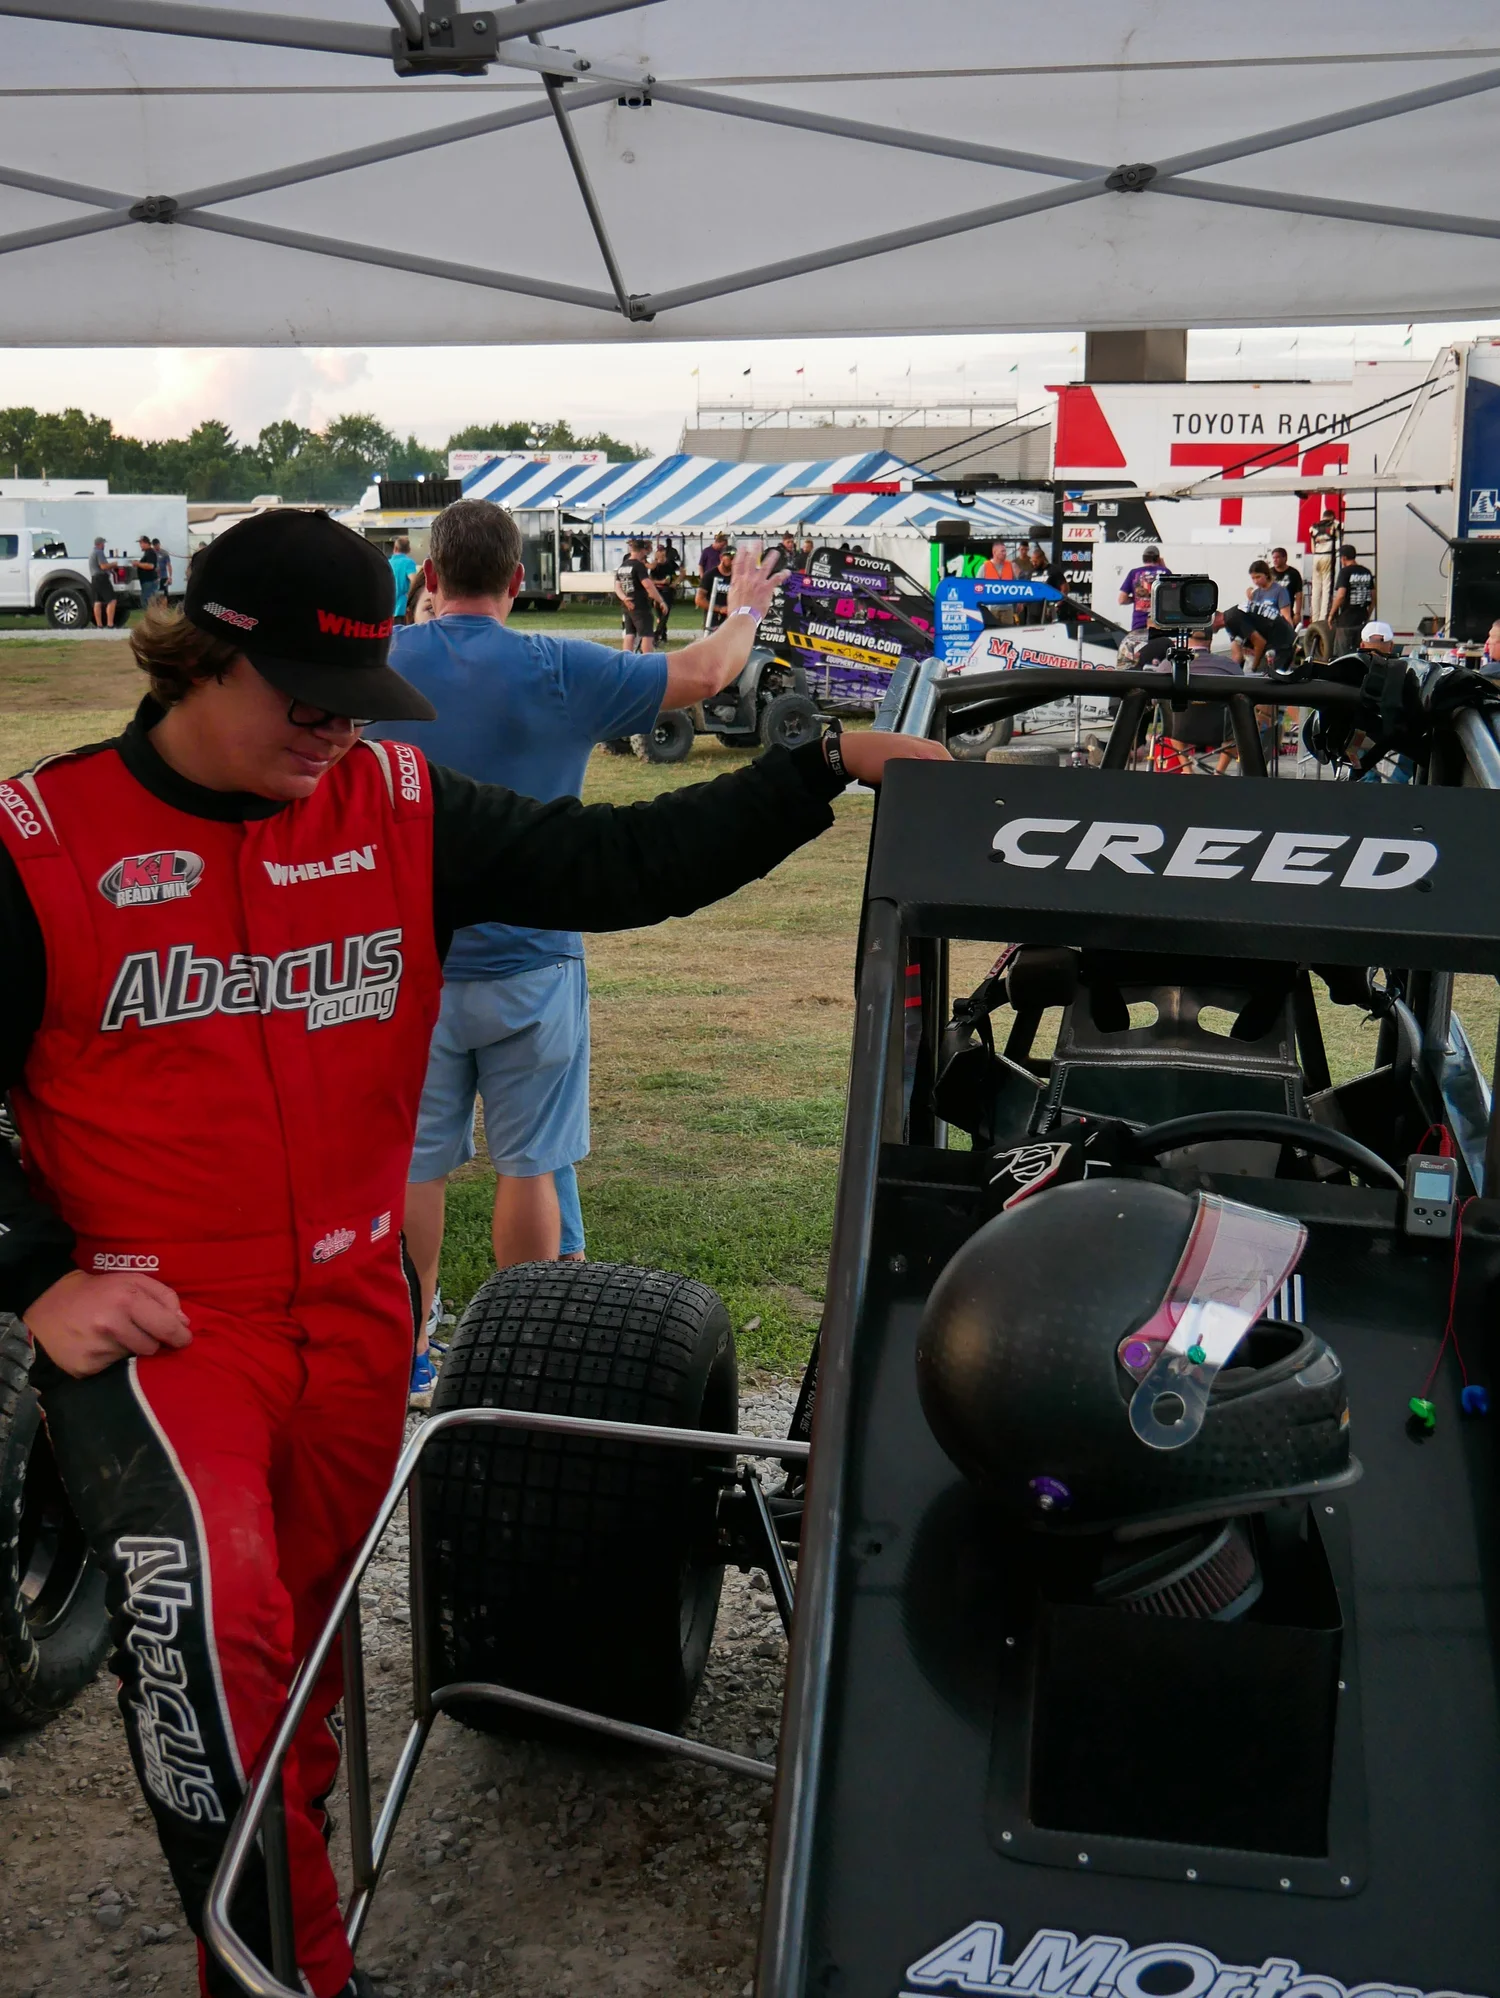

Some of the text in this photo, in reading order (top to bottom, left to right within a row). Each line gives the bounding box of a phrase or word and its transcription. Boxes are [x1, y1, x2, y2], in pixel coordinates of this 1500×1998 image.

[1172, 413, 1264, 434] TOYOTA
[1068, 528, 1095, 538] IWX
[854, 557, 891, 572] TOYOTA
[1062, 551, 1092, 561] Mobil
[811, 578, 853, 593] TOYOTA
[848, 574, 882, 587] TOYOTA
[984, 584, 1034, 596] TOYOTA
[942, 623, 962, 631] Mobil
[759, 633, 787, 643] CURB
[808, 622, 903, 655] purplewave.com
[944, 656, 977, 667] CURB
[394, 744, 421, 803] sparco
[992, 817, 1438, 890] CREED
[120, 852, 187, 890] K&L
[263, 845, 377, 887] WHELEN
[116, 881, 190, 908] READY MIX
[100, 927, 403, 1032] Abacus
[306, 982, 399, 1031] racing
[92, 1252, 160, 1271] sparco
